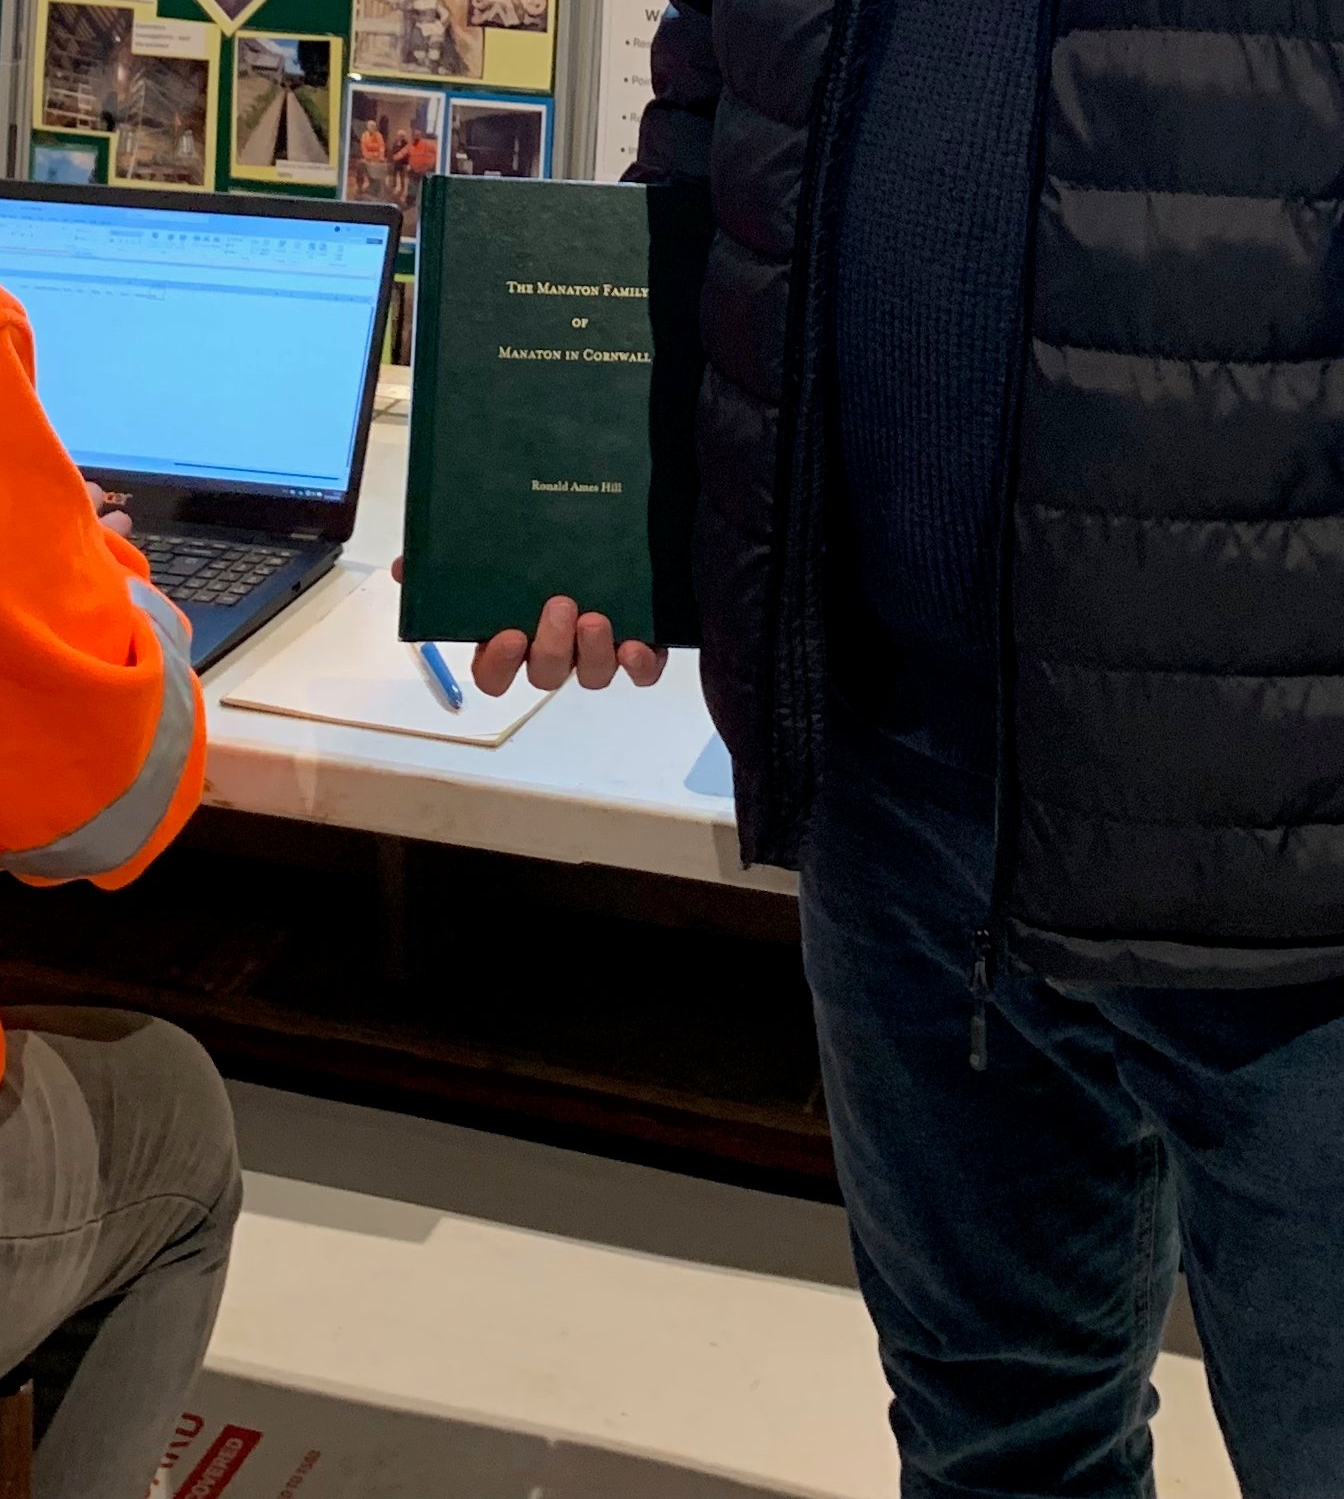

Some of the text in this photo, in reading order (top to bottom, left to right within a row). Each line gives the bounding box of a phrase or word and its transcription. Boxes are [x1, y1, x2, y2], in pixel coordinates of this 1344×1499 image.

[531, 479, 623, 494] Ronald Ames Hill
